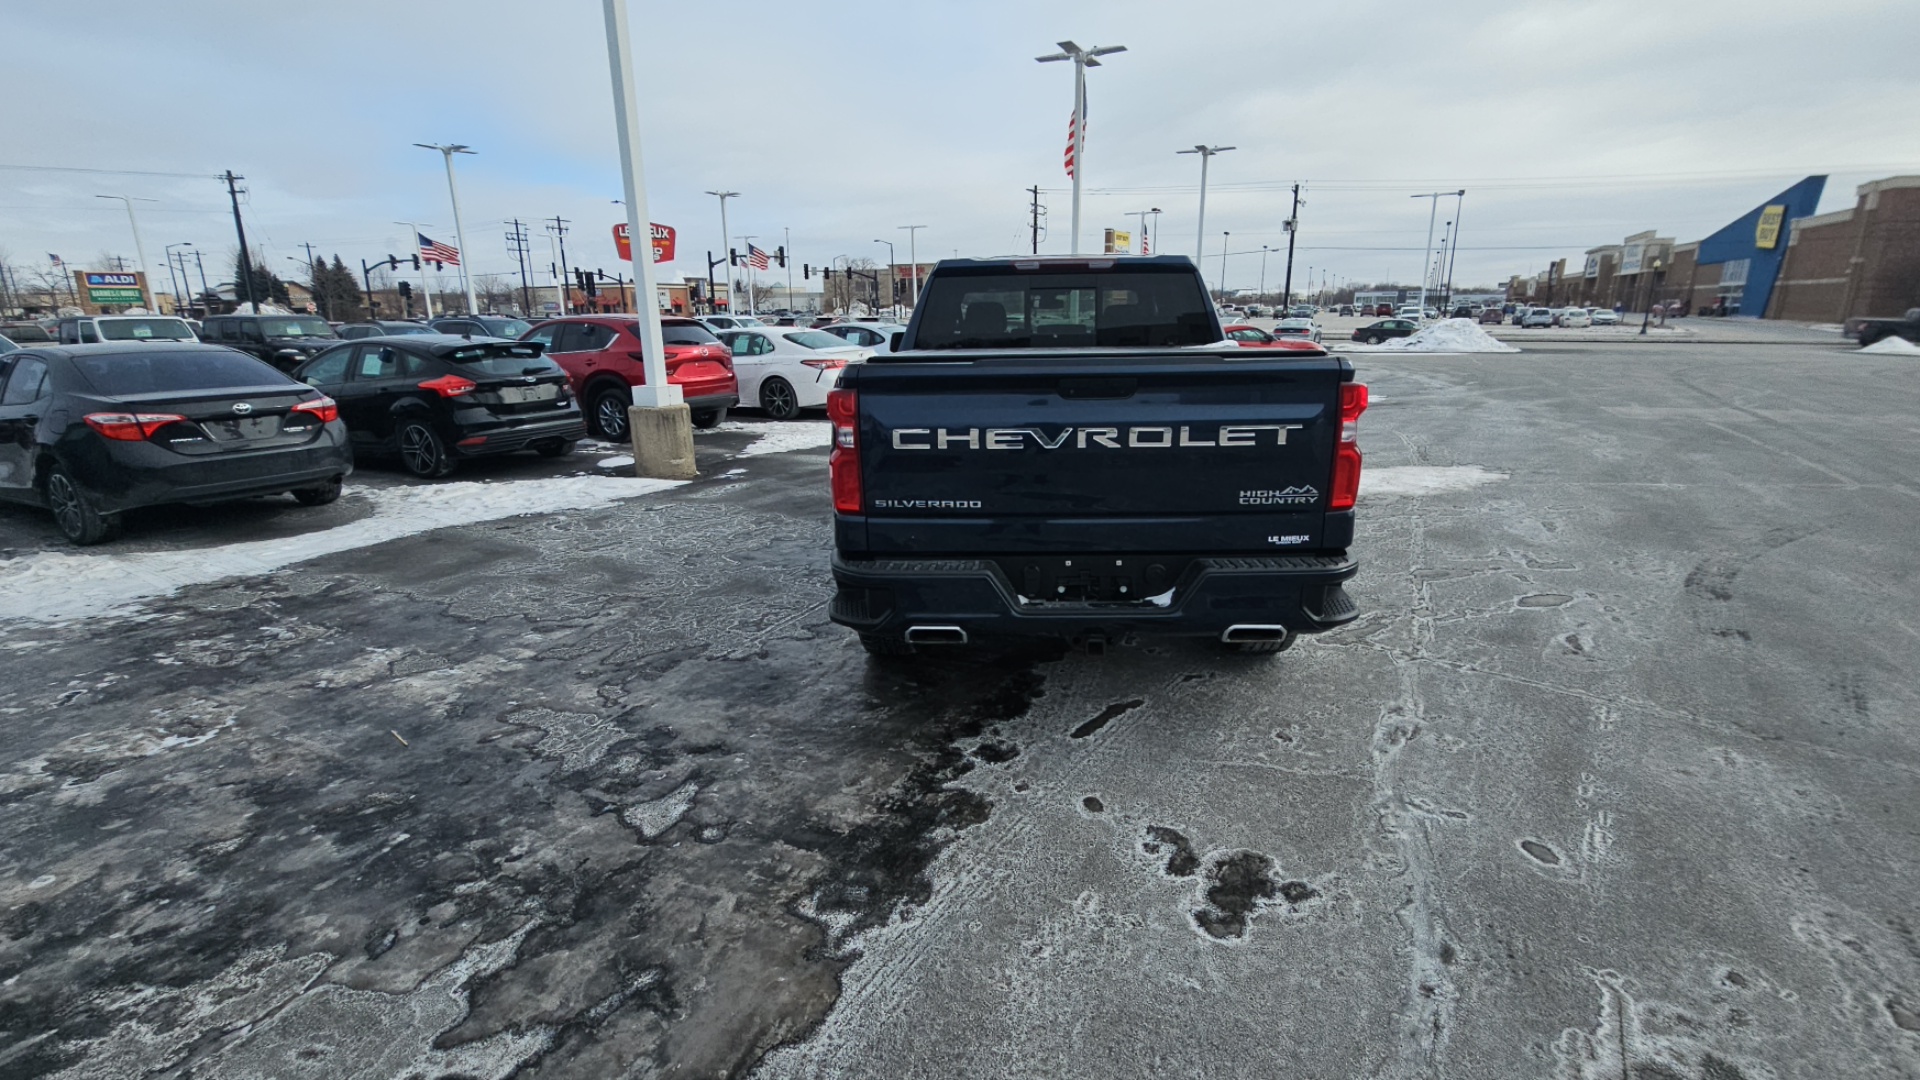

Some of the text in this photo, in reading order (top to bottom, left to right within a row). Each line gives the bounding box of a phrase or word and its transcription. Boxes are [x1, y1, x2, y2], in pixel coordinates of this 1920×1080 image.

[1762, 213, 1781, 225] BEST
[1759, 227, 1776, 240] BUY
[104, 275, 134, 283] ALDI
[892, 424, 1303, 449] CHEVROLET
[874, 499, 982, 508] SILVERADO
[1239, 496, 1318, 504] COUNTRY
